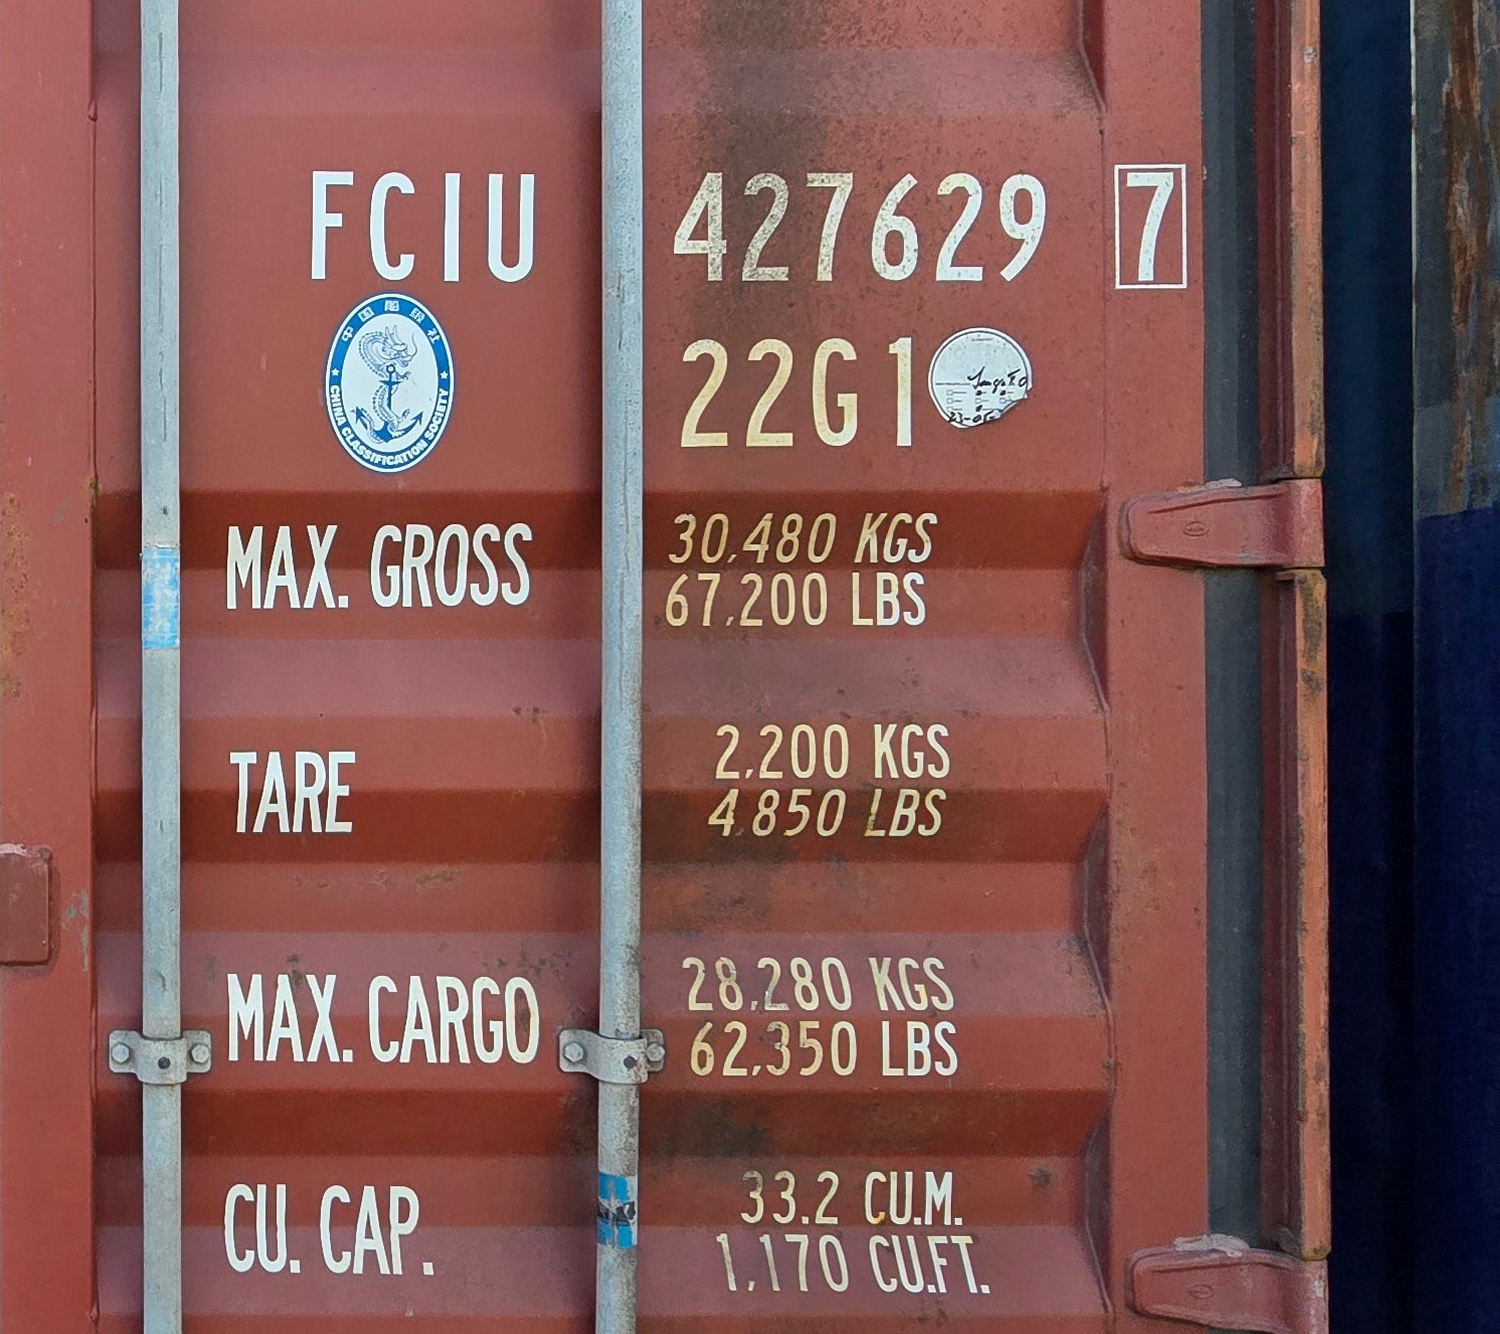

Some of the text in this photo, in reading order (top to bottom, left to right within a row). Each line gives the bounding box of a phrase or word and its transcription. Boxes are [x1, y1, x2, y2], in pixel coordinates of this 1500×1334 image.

[311, 171, 1175, 283] FCIU 427629 7
[680, 335, 912, 449] 22G1
[329, 384, 449, 466] CHINA CLASSIFICATION SOCIETY
[226, 522, 533, 610] MAX. GROSS
[668, 512, 939, 564] 30,480 KGS
[664, 572, 927, 627] 67,200 LBS
[715, 723, 950, 780] 2,200 KGS
[229, 751, 356, 833] TARE
[863, 788, 947, 838] LBS
[682, 956, 954, 1011] 28,280 KGS
[227, 973, 540, 1064] MAX. CARGO
[690, 1020, 959, 1077] 62,350 LBS
[739, 1170, 964, 1226] 33.2 CU.M.
[223, 1183, 434, 1277] CU. CAP.
[716, 1232, 991, 1295] 1,170 CU.FT.
